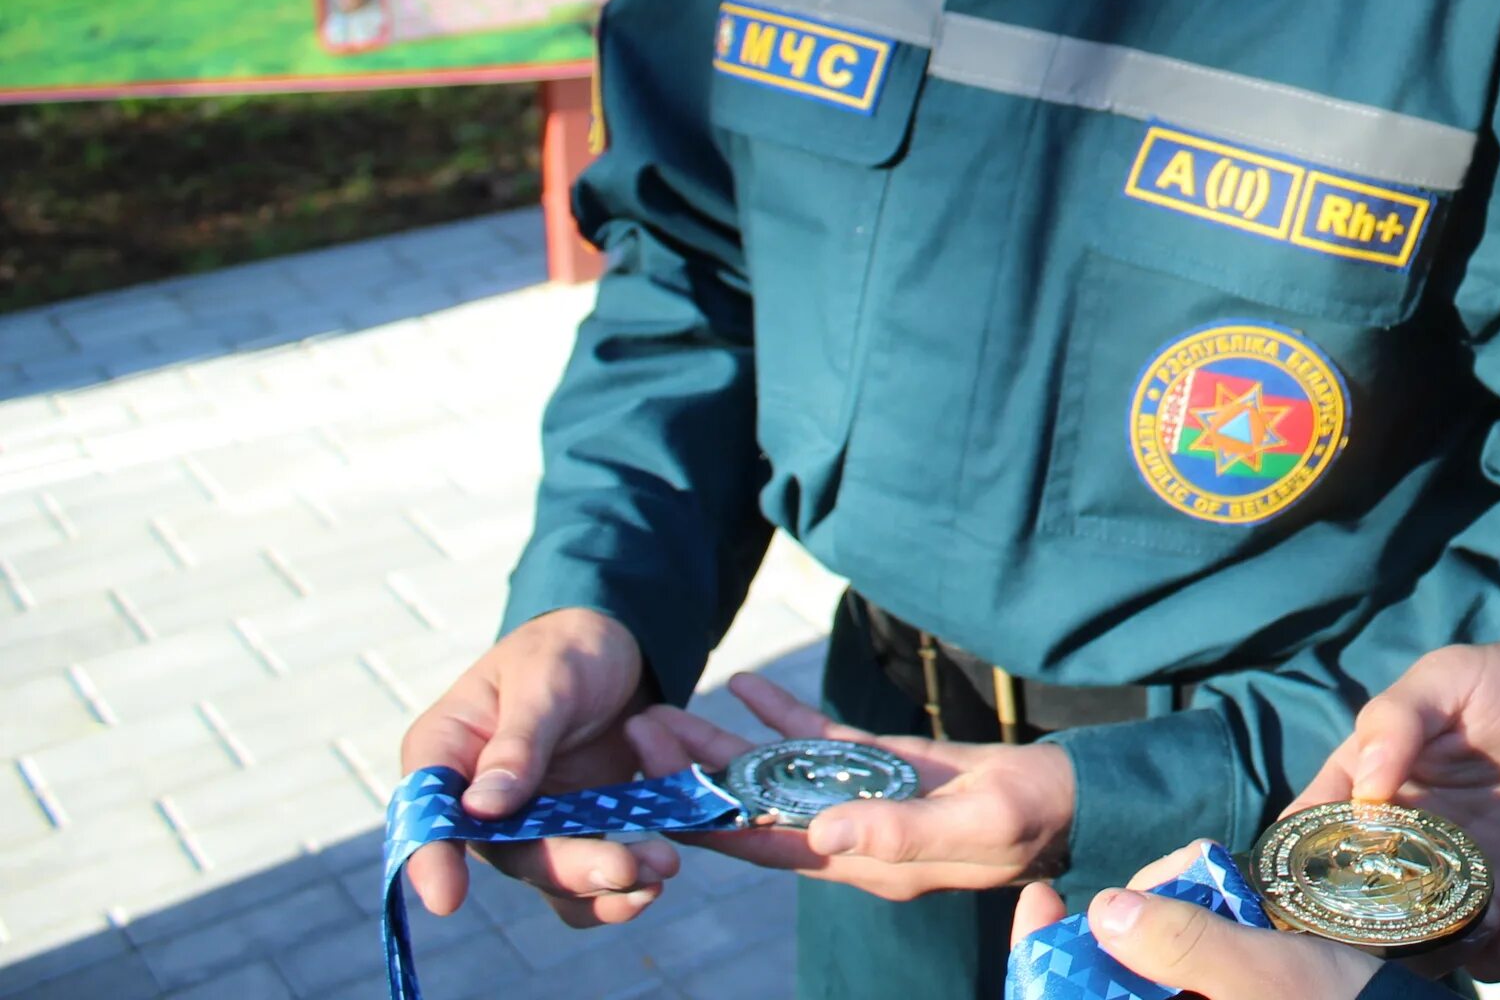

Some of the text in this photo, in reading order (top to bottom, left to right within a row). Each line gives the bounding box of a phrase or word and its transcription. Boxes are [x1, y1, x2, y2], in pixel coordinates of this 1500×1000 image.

[739, 21, 859, 89] МЧС
[1154, 149, 1196, 197] A
[1315, 192, 1405, 244] Rh+
[1193, 497, 1223, 515] OF
